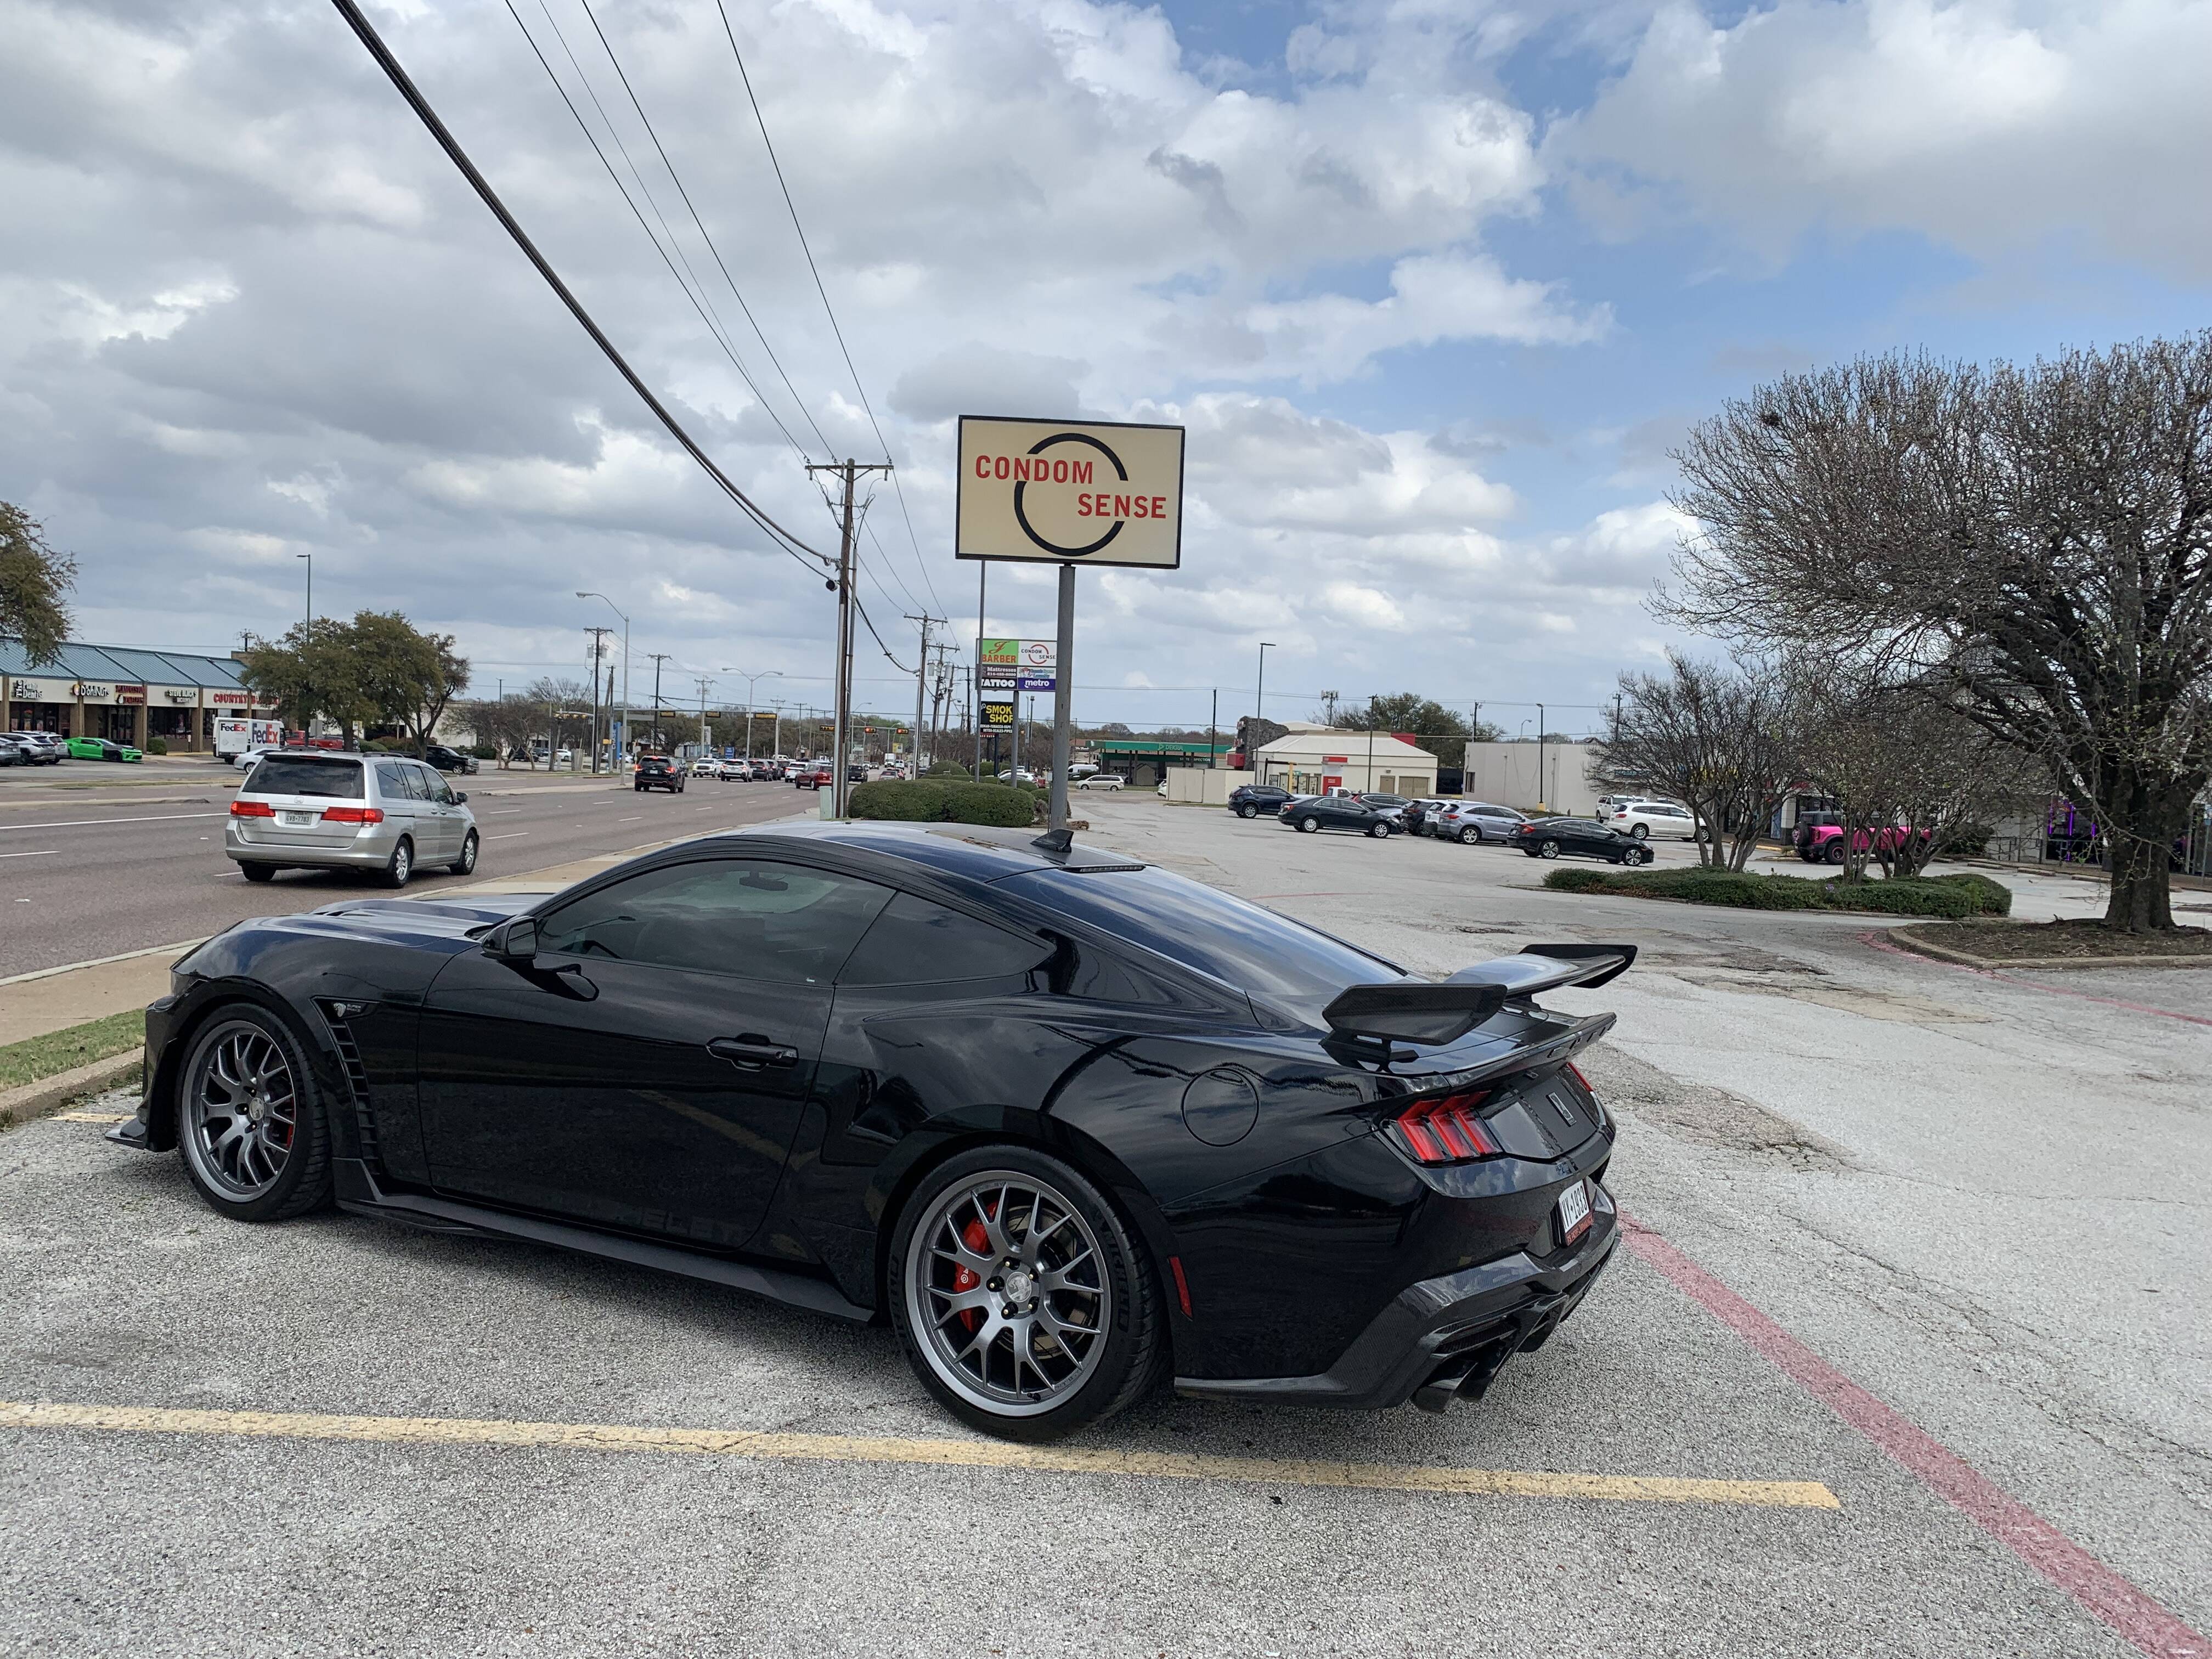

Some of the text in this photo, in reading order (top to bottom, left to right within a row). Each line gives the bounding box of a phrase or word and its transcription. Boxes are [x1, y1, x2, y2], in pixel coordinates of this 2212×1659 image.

[975, 455, 1093, 484] CONDOM
[1077, 493, 1166, 519] SENSE
[983, 654, 1017, 663] BARBER
[981, 679, 1015, 687] TATTOO
[213, 693, 247, 704] COUNTRY
[986, 705, 1013, 714] SMOK
[221, 723, 246, 732] FedEx
[252, 723, 278, 744] FedEx
